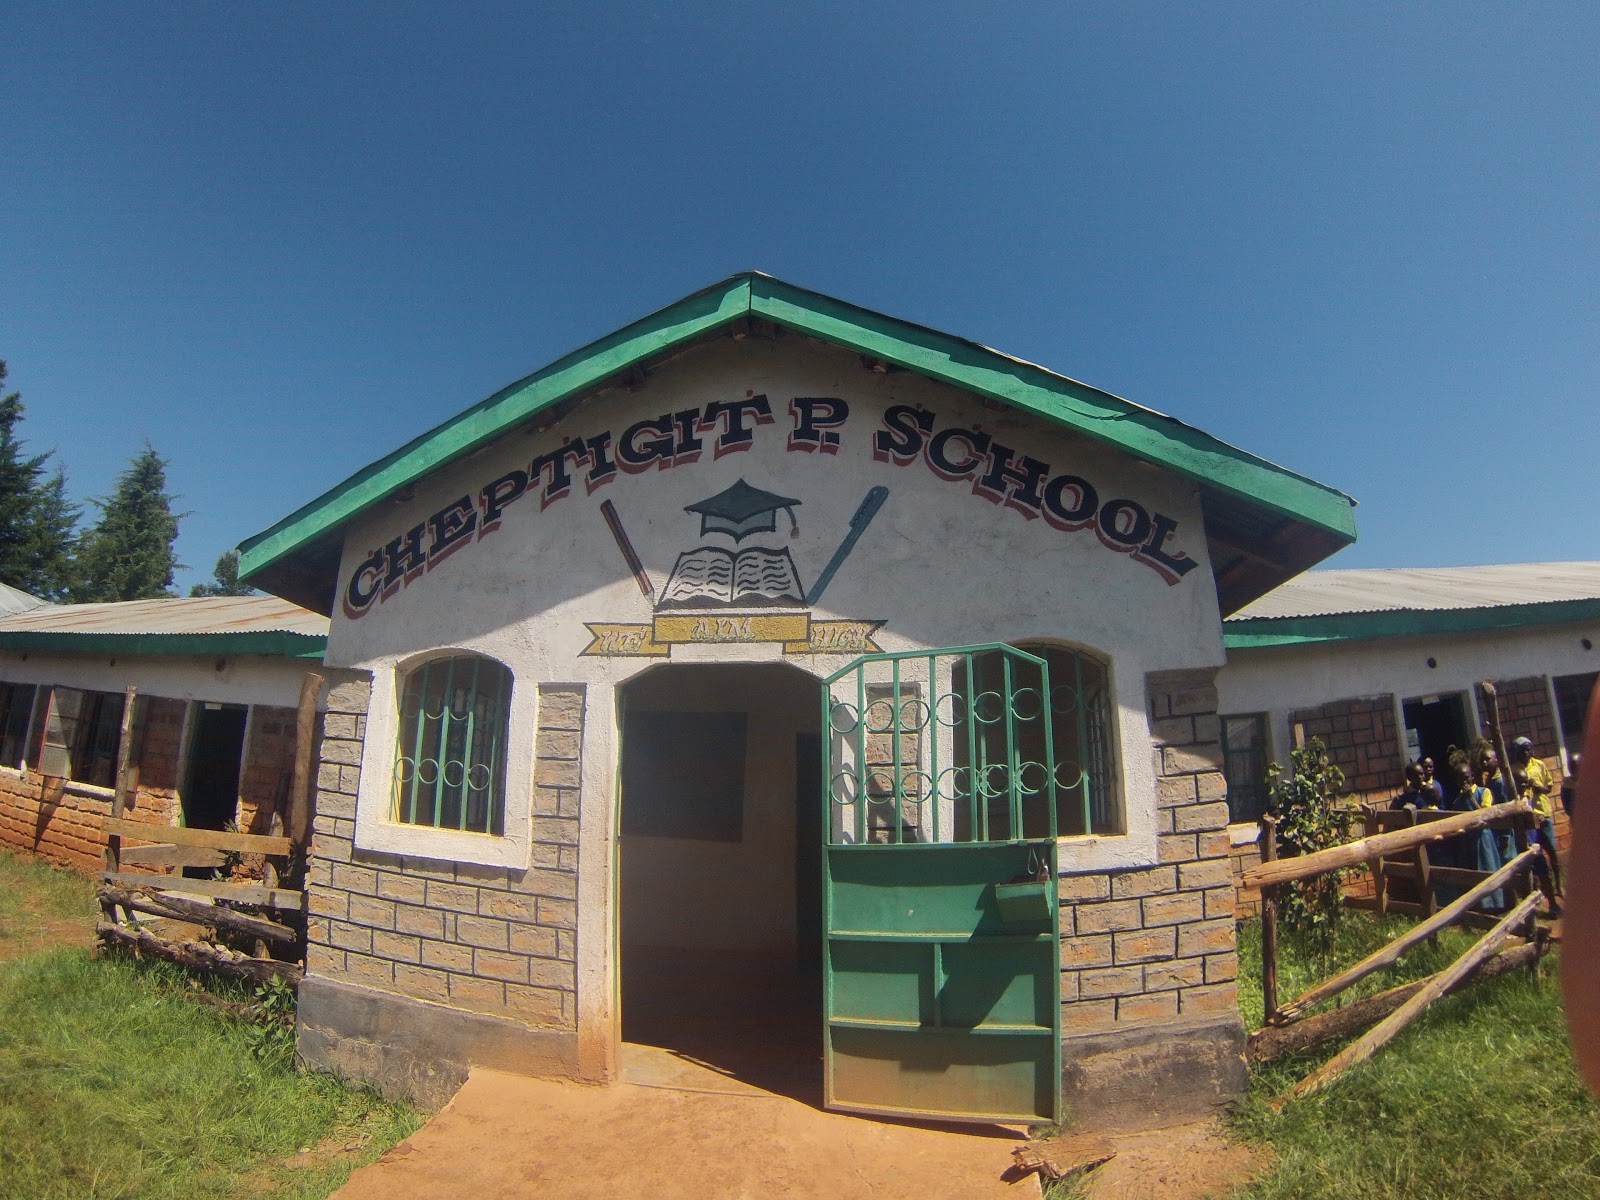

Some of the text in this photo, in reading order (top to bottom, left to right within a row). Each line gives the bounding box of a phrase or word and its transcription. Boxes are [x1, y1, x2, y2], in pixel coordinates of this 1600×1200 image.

[343, 393, 775, 619] CHEPTIGIT
[873, 404, 1199, 587] SCHOOL
[690, 617, 757, 642] AIM
[809, 626, 868, 652] HIGH
